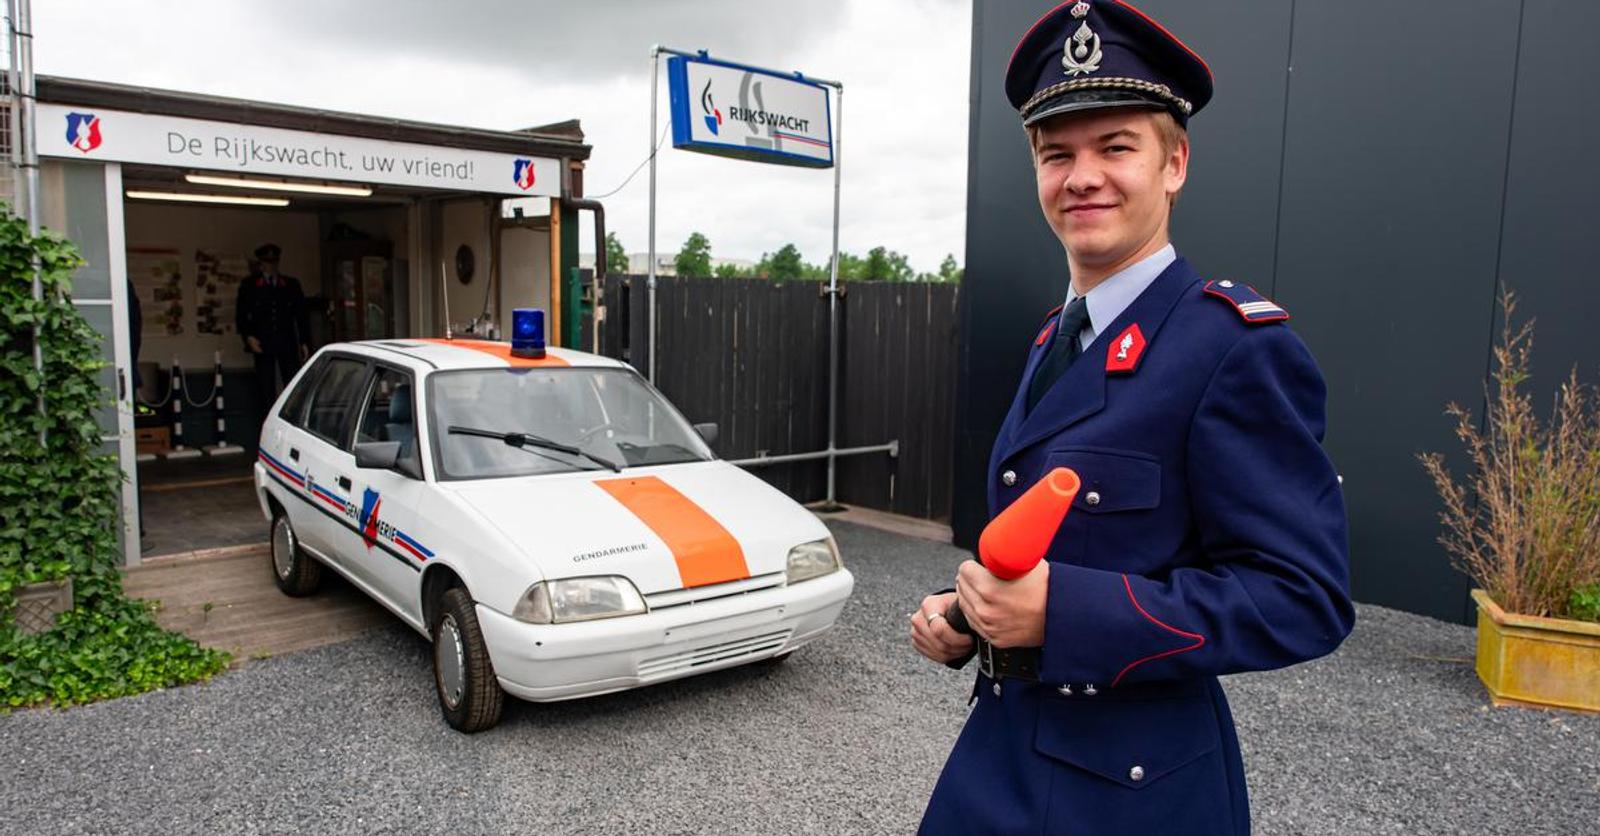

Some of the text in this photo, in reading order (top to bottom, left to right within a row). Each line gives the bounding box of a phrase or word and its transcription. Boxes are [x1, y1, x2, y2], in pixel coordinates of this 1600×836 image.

[729, 106, 810, 132] RIJKSWACHT
[168, 132, 202, 156] De
[362, 155, 395, 173] uw
[402, 157, 474, 180] vriend!
[573, 542, 648, 563] GENDARMERIE
